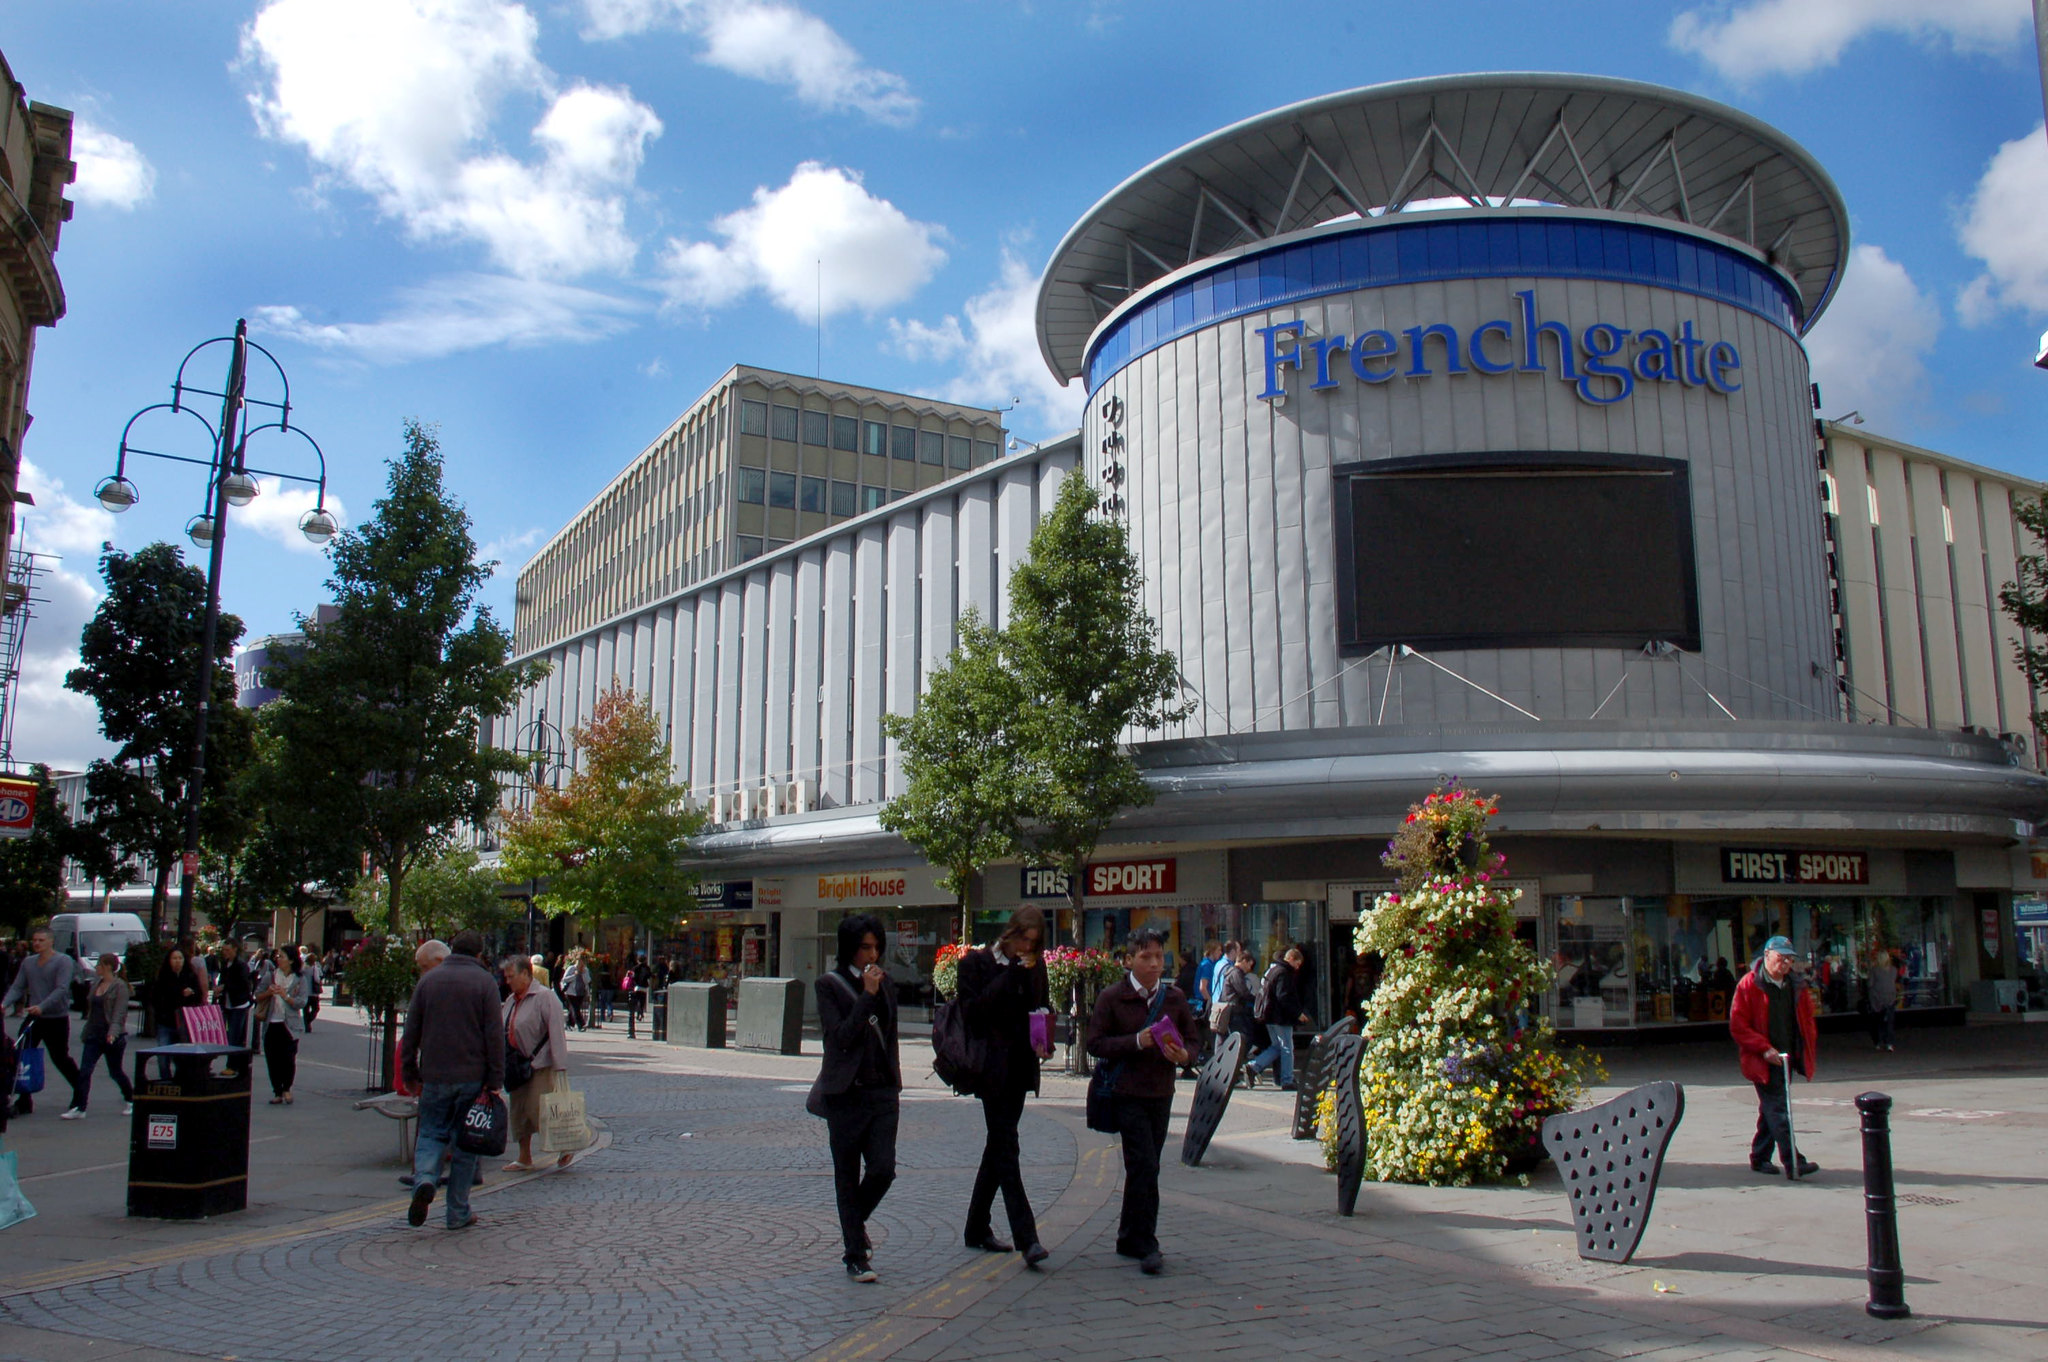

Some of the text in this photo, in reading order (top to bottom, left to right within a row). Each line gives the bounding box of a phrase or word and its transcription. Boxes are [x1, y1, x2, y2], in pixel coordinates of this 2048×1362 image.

[1255, 290, 1742, 406] Frenchgate
[0, 787, 29, 798] hones
[1729, 851, 1862, 880] FIRST SPORT
[1026, 863, 1166, 895] FIRS SPORT
[700, 882, 722, 896] Works
[758, 887, 782, 896] Bright
[817, 875, 905, 902] Bright House
[758, 896, 782, 905] House
[195, 1020, 221, 1032] BANK
[146, 1084, 182, 1096] LITTER
[465, 1108, 492, 1129] 50%
[152, 1125, 174, 1138] £75
